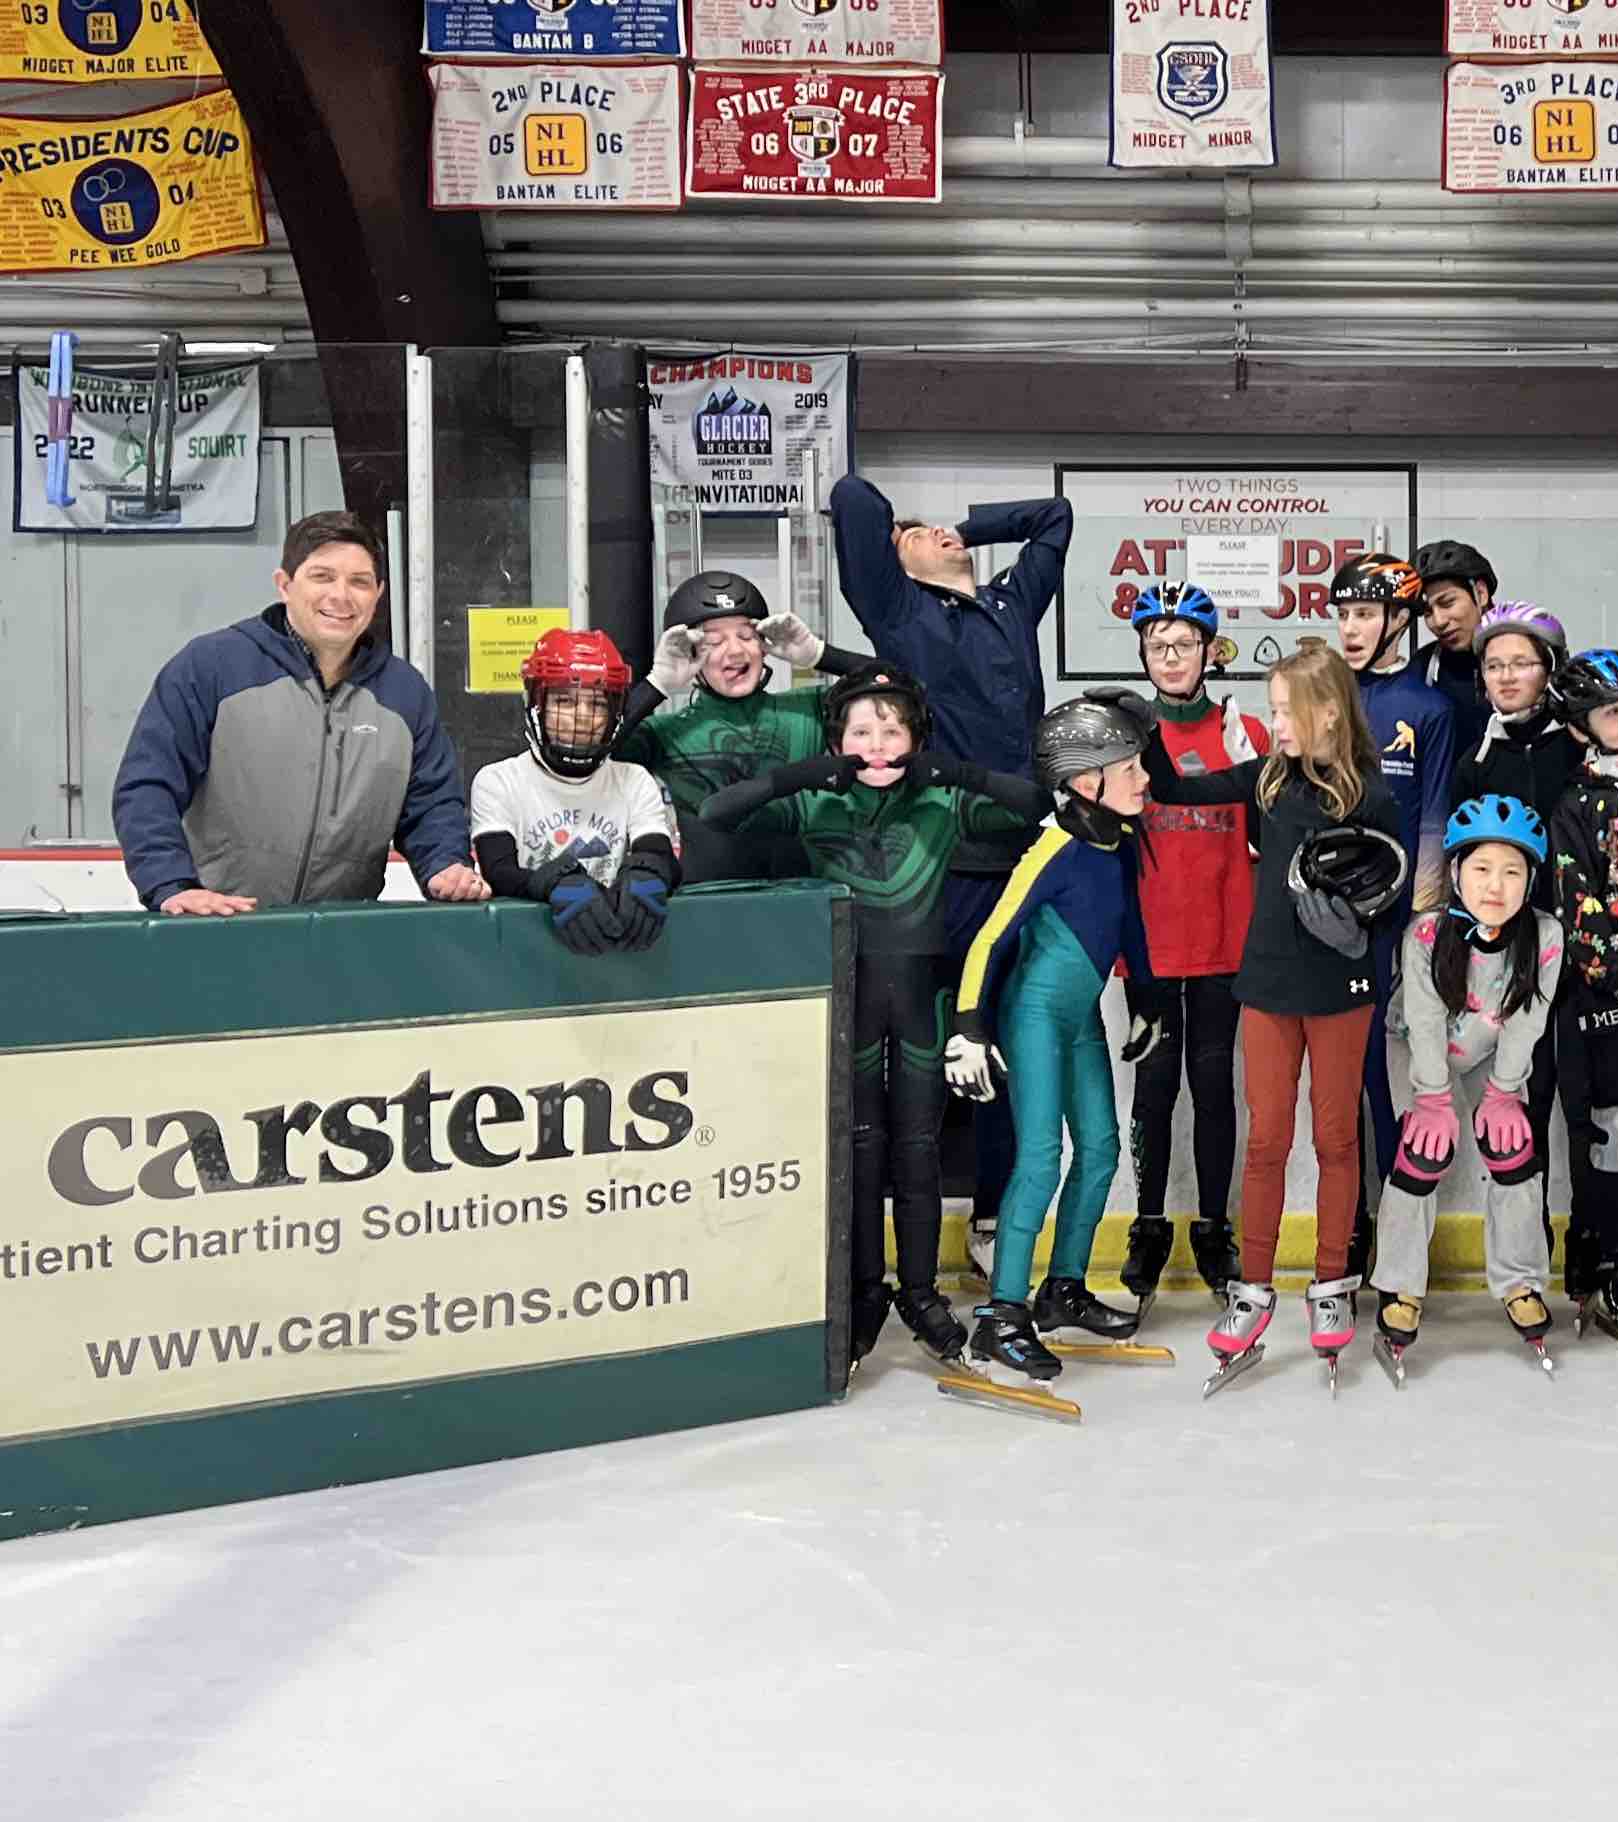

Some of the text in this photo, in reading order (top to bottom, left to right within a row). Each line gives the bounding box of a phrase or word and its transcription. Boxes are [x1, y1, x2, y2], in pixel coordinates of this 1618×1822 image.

[21, 3, 48, 24] 03
[151, 1, 180, 23] 04
[1126, 0, 1251, 23] 2ND PLACE
[513, 33, 593, 49] BANTAM B
[742, 40, 895, 56] MIDGET AA MAJOR
[1492, 34, 1548, 49] MIDGET
[1563, 35, 1583, 49] AA
[23, 56, 189, 74] MIDGET MAJOR ELITE
[491, 81, 616, 113] 2ND PLACE
[1500, 79, 1537, 104] 3RD
[716, 83, 916, 125] STATE 3RD PLACE
[1546, 110, 1574, 127] NI
[536, 123, 566, 140] NI
[1132, 130, 1253, 149] MIDGET MINOR
[1494, 124, 1522, 145] 06
[184, 127, 240, 159] CUP
[489, 133, 515, 155] 05
[596, 133, 623, 154] 06
[751, 133, 779, 155] 06
[849, 134, 878, 156] 07
[1547, 136, 1583, 153] HL
[538, 149, 573, 166] HL
[743, 175, 885, 193] MIDGET AA MAJOR
[1507, 168, 1566, 184] BANTAM
[497, 184, 618, 200] BANTAM ELITE
[41, 198, 66, 219] 03
[70, 238, 181, 264] PEE WEE GOLD
[650, 358, 813, 384] CHAMPIONS
[72, 394, 208, 414] RUNNE UP
[795, 393, 828, 409] 2019
[701, 415, 769, 441] GLACIER
[35, 434, 94, 460] 222
[188, 435, 247, 458] SQUIRT
[707, 444, 766, 454] HOCKEY
[698, 458, 746, 466] TOURNAMENT
[712, 469, 735, 480] MITE
[1176, 479, 1298, 493] TWO THINGS
[1143, 499, 1329, 513] YOU CAN CONTROL
[1181, 518, 1246, 534] EVERY
[493, 672, 522, 681] THAN
[525, 809, 625, 850] EXPLORE MORE
[47, 1069, 693, 1206] carstens
[0, 1160, 801, 1278] tient Charting Solutions since 1955
[87, 1266, 689, 1380] www.carstens.com
